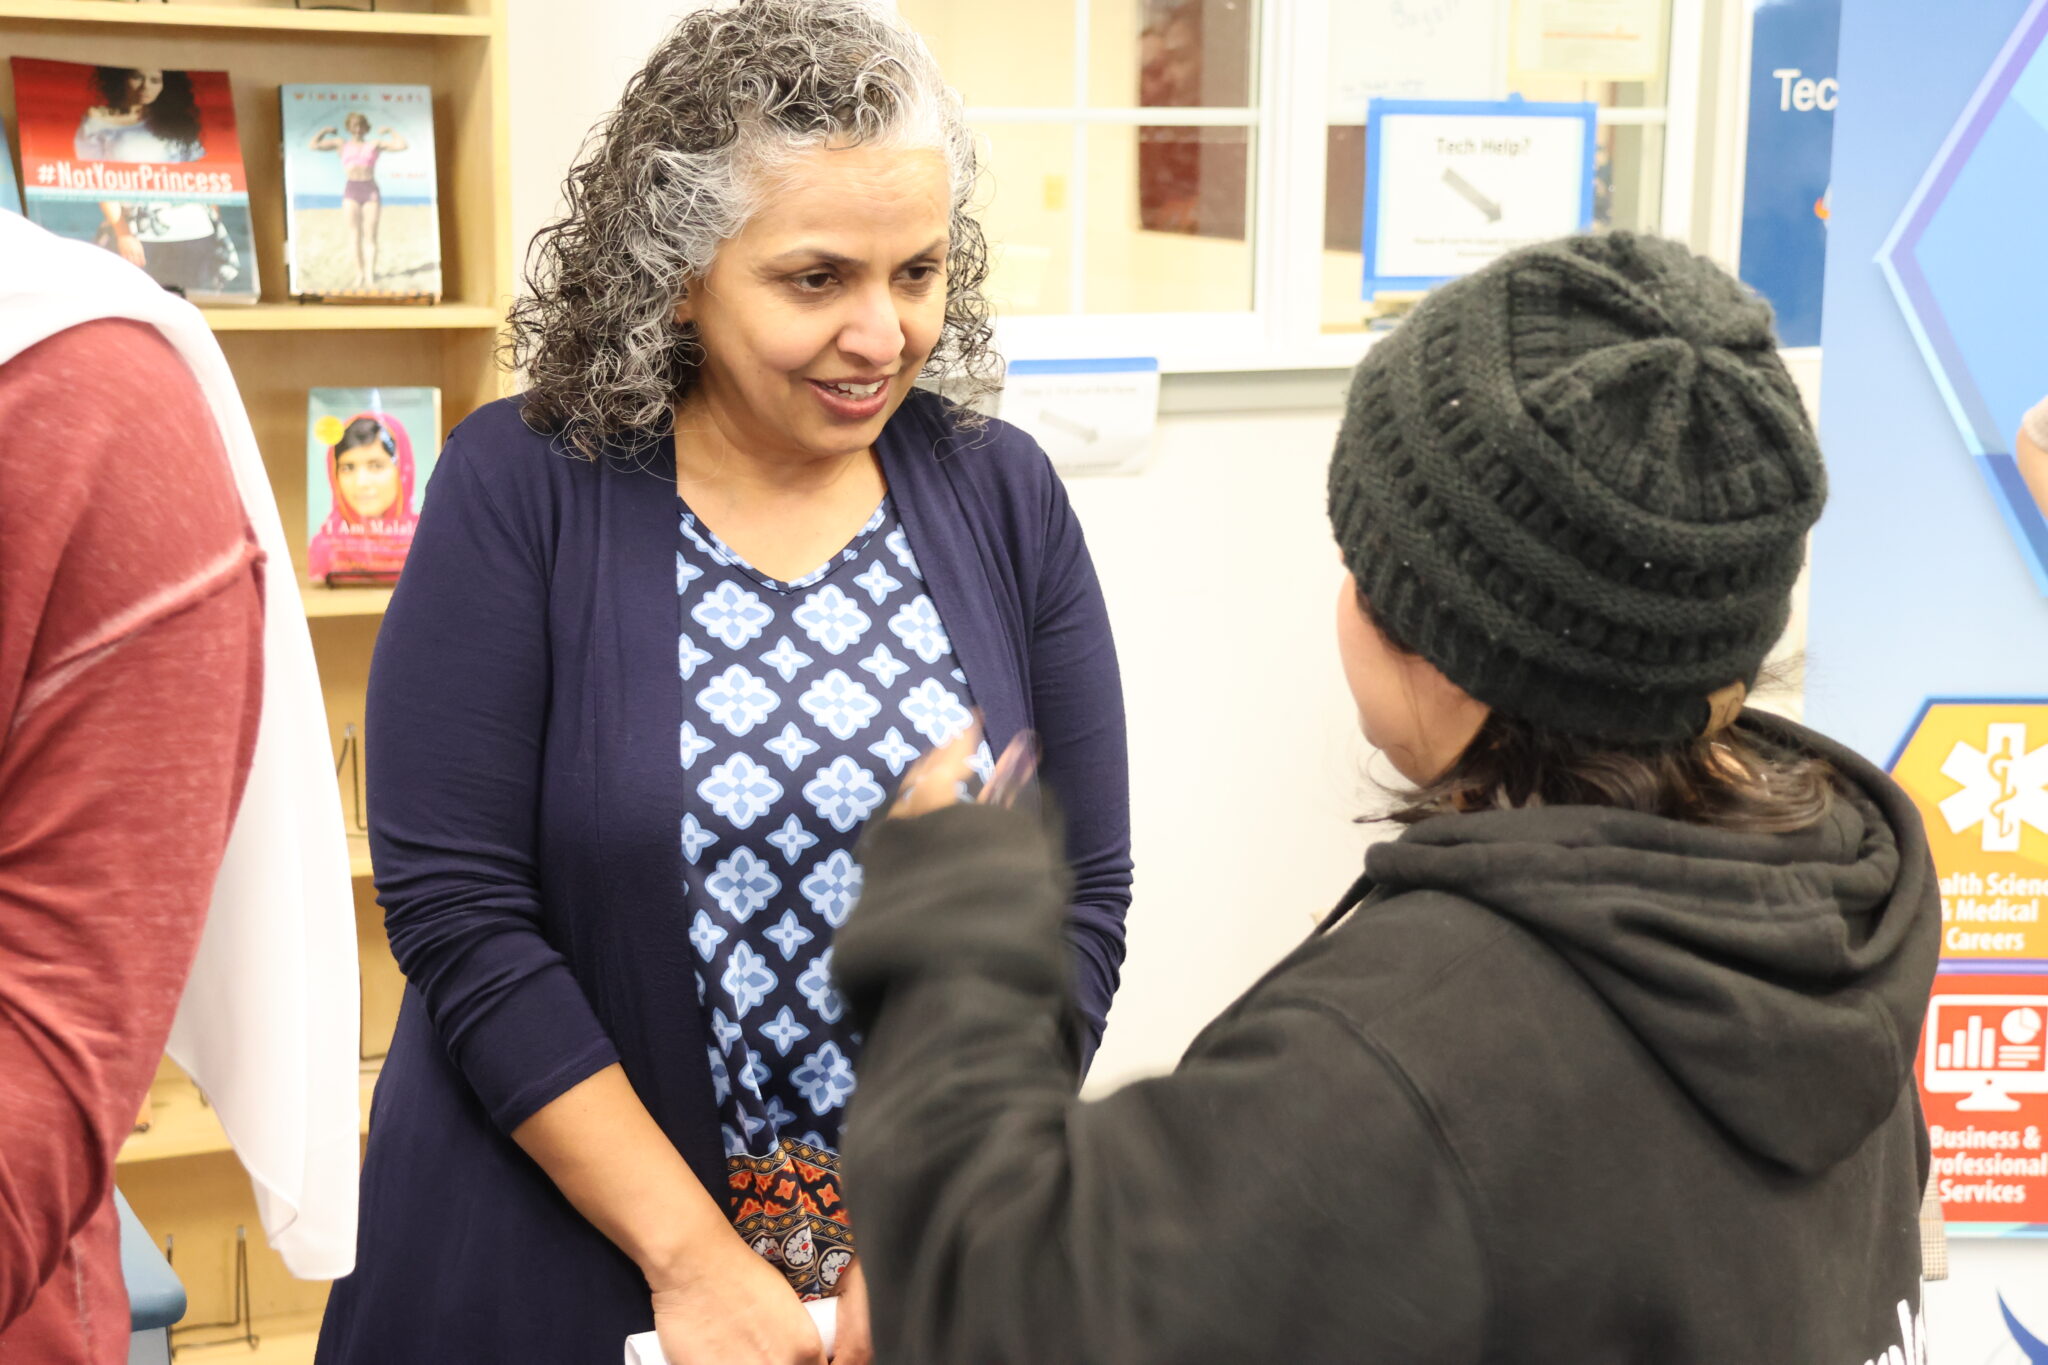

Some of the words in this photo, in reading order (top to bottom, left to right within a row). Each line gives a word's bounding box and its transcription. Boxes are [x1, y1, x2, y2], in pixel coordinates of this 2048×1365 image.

[1772, 68, 1839, 112] Tec
[1435, 136, 1476, 155] Tech
[37, 160, 233, 193] #NotYourPrincess
[327, 520, 333, 535] I
[339, 520, 365, 536] Am
[370, 519, 416, 536] Malal
[1939, 872, 1982, 896] alth
[1986, 872, 2048, 896] Scienc
[1956, 898, 2039, 922] Medical
[1946, 926, 2024, 951] Careers
[1930, 1125, 2020, 1149] Business
[2022, 1125, 2041, 1149] &
[1934, 1151, 2048, 1176] rofessional
[1940, 1179, 2026, 1203] Services
